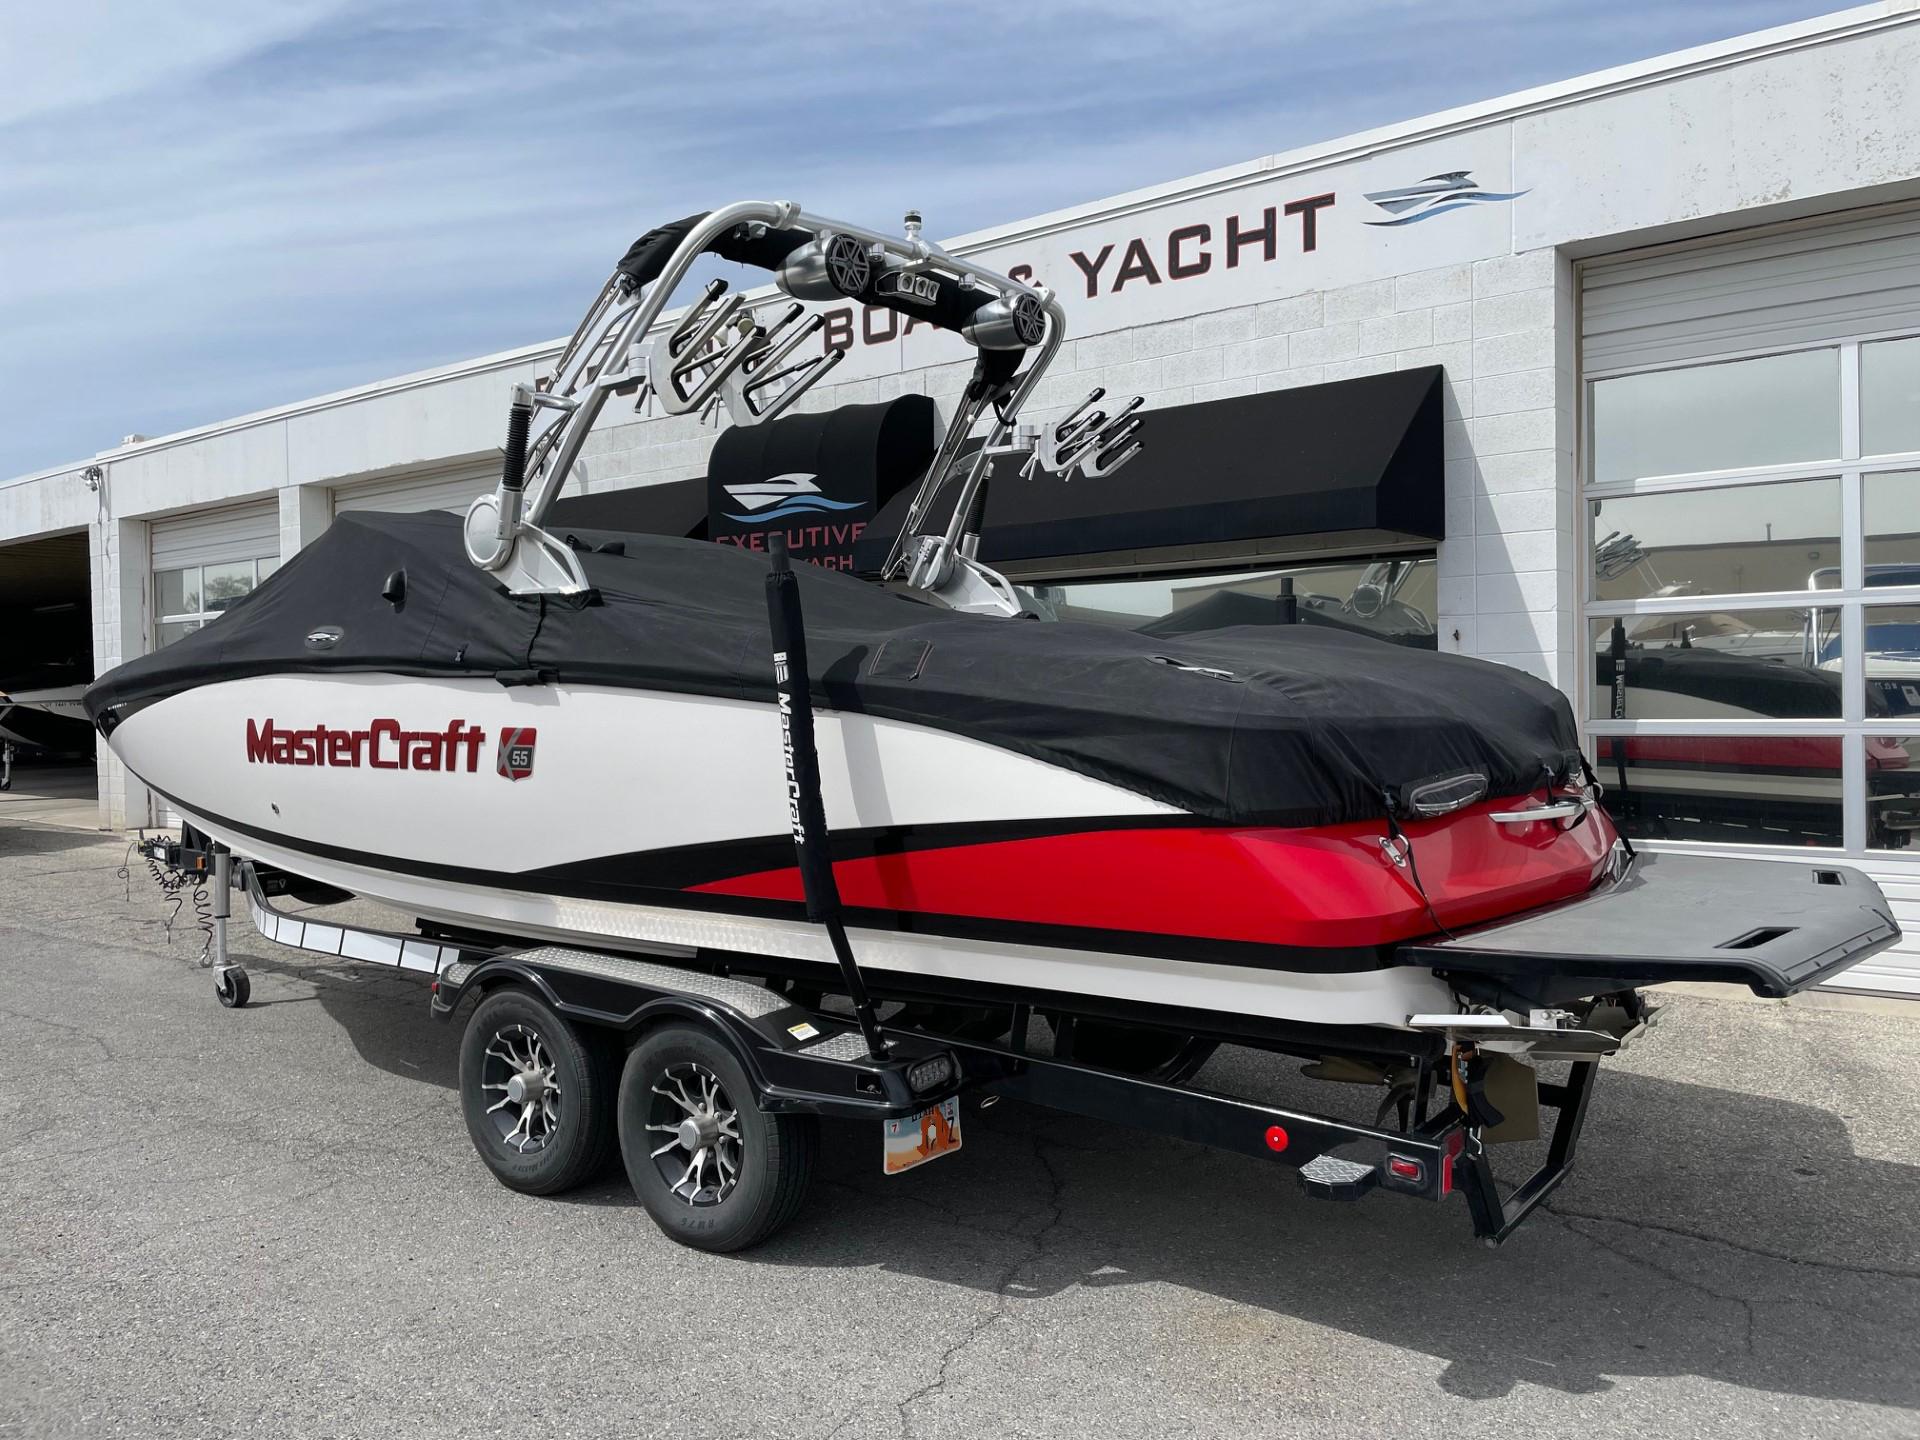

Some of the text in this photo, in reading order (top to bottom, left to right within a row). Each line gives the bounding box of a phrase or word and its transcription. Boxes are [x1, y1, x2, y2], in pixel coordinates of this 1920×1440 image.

[1069, 192, 1335, 299] YACHT
[246, 718, 486, 772] MasterCraft
[511, 750, 529, 766] 55
[778, 692, 805, 845] MasterCraft
